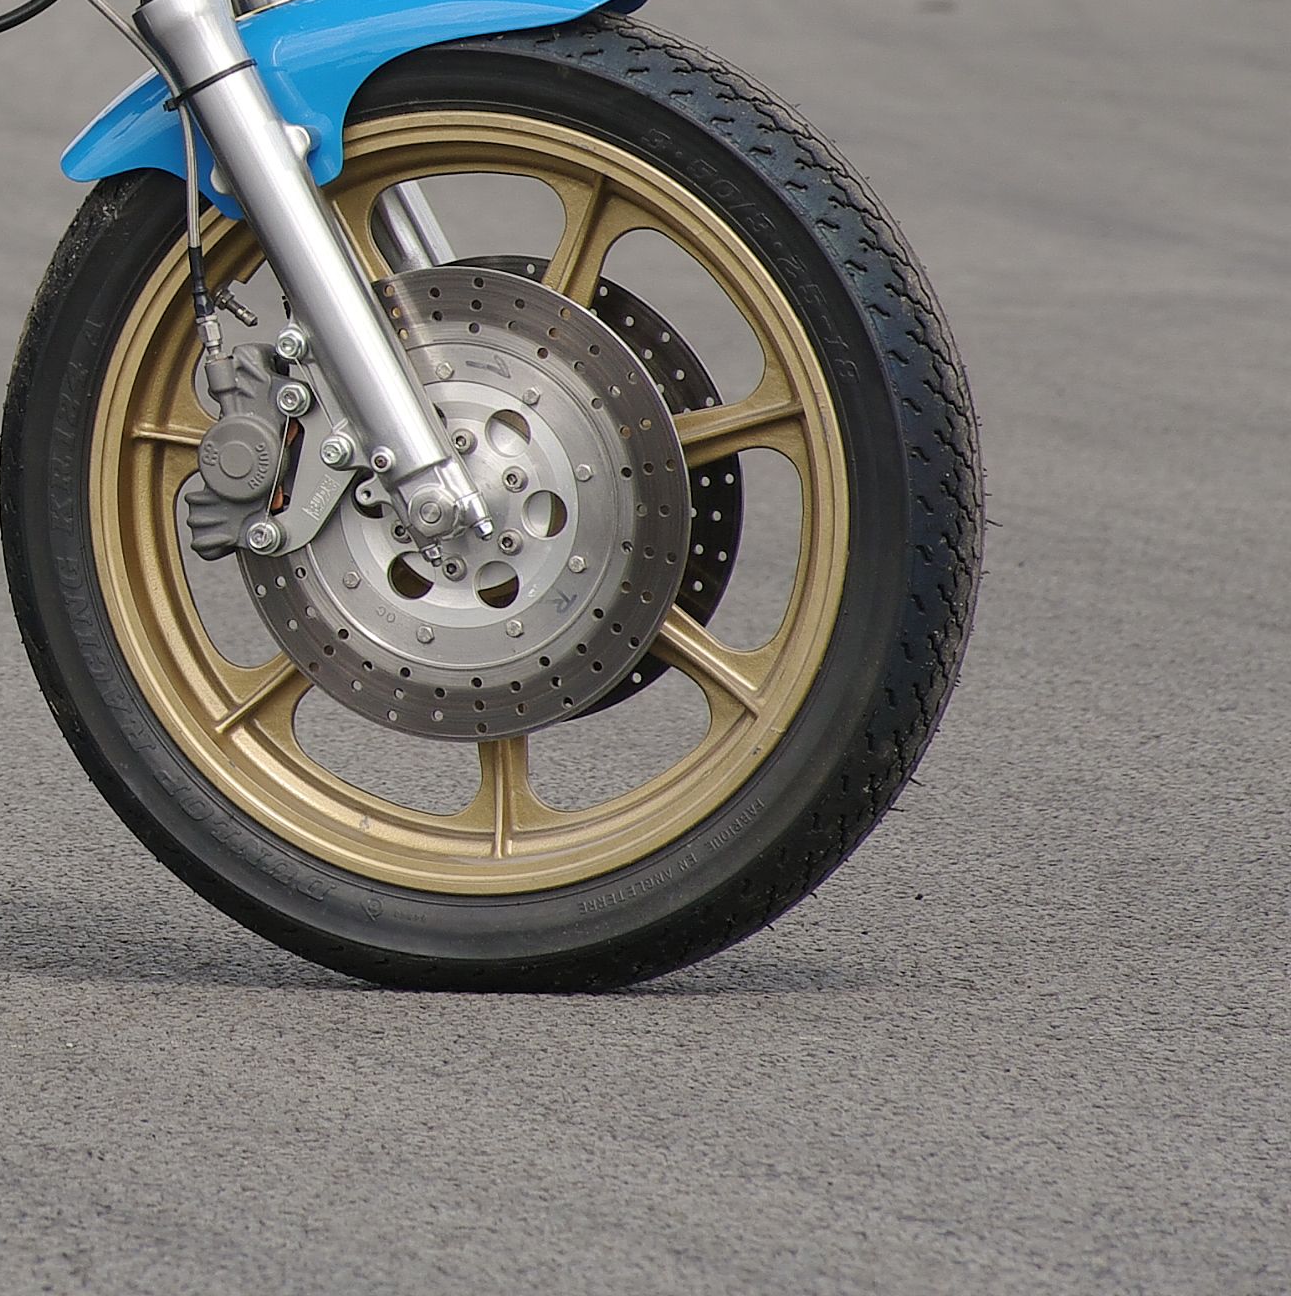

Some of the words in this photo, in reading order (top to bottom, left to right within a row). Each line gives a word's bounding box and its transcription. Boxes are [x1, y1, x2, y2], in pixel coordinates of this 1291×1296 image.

[53, 552, 158, 759] RACING
[149, 758, 338, 906] DUNLOP
[673, 850, 698, 874] EN
[575, 863, 676, 917] ANGLETERRE
